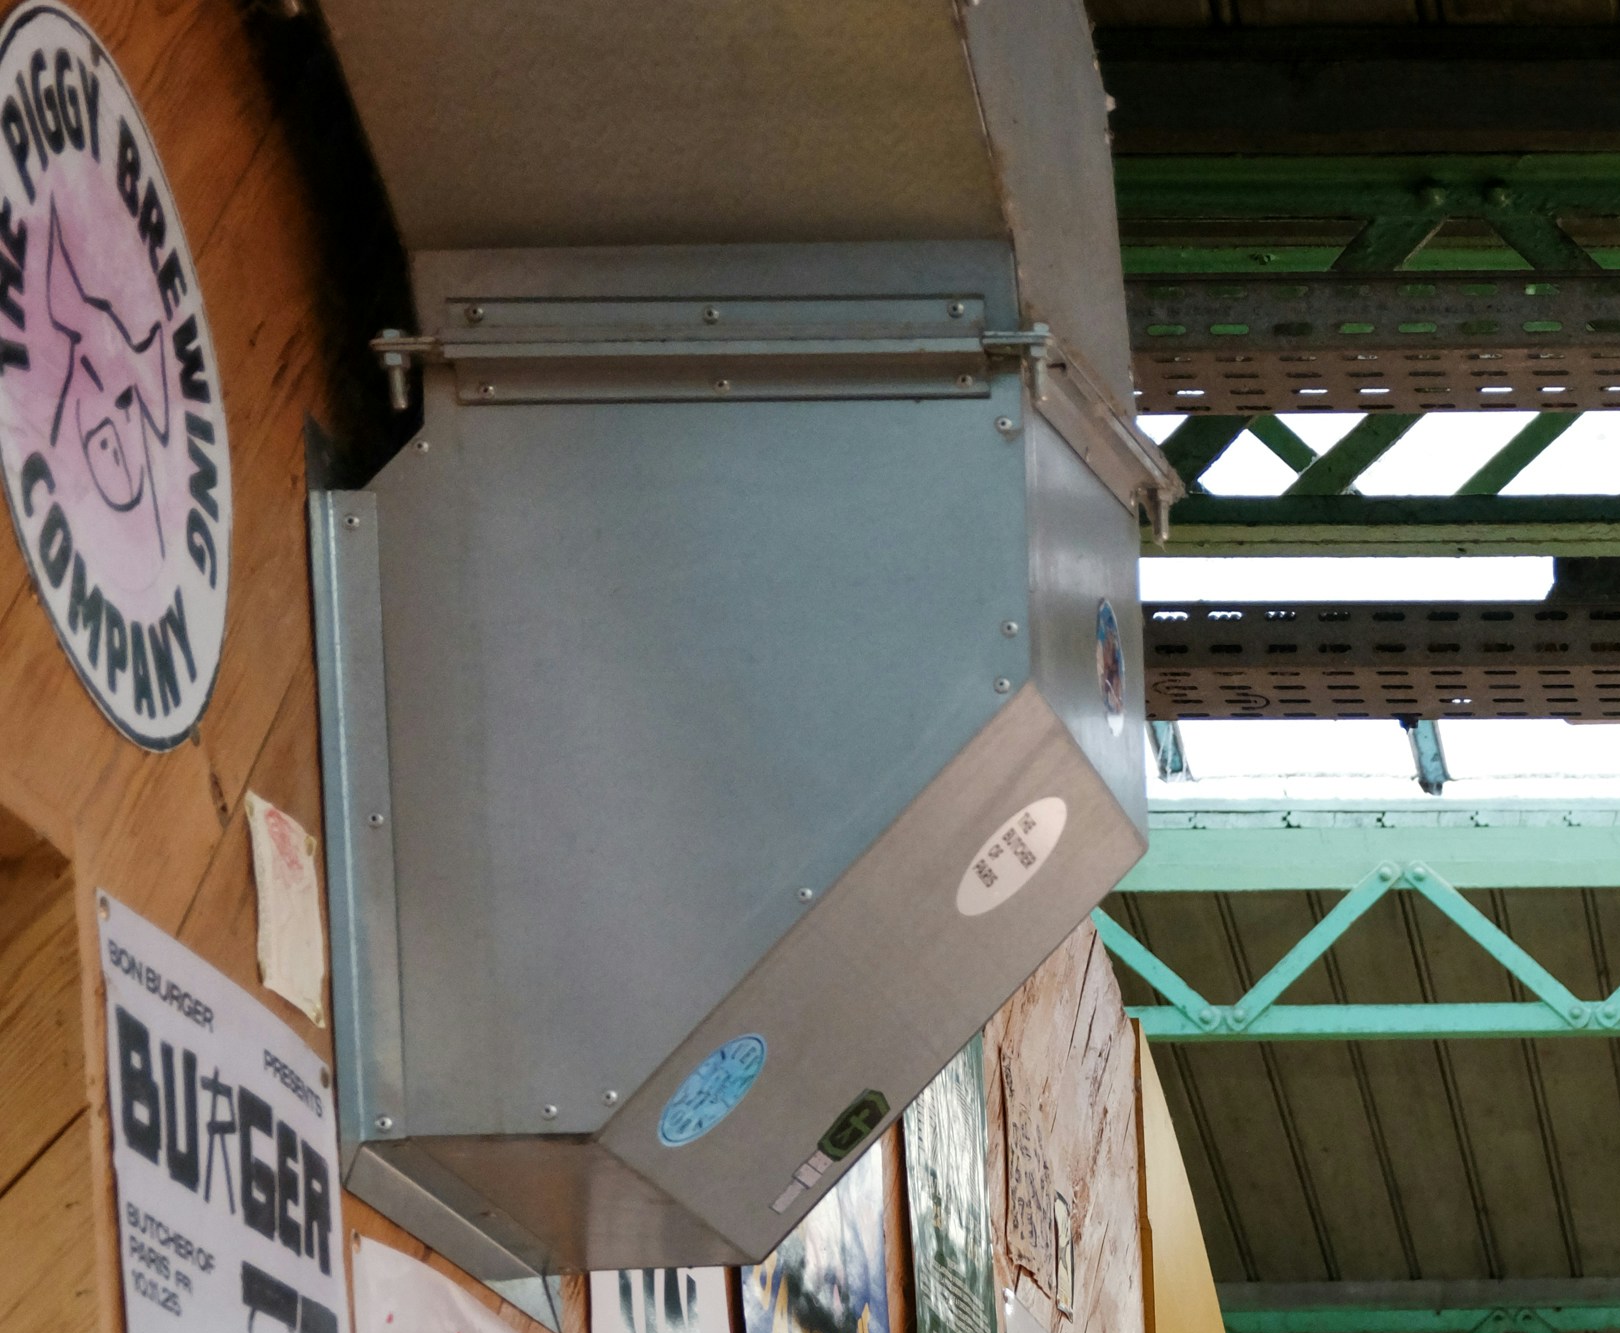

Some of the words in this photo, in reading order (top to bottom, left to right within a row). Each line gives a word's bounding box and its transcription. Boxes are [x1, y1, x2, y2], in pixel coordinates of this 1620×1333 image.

[0, 47, 101, 206] PIGGY
[116, 114, 218, 590] BREWING
[20, 450, 197, 721] COMPANY
[115, 1004, 332, 1278] BURGER
[146, 972, 215, 1034] BURGER
[263, 1048, 324, 1120] PRESENTS
